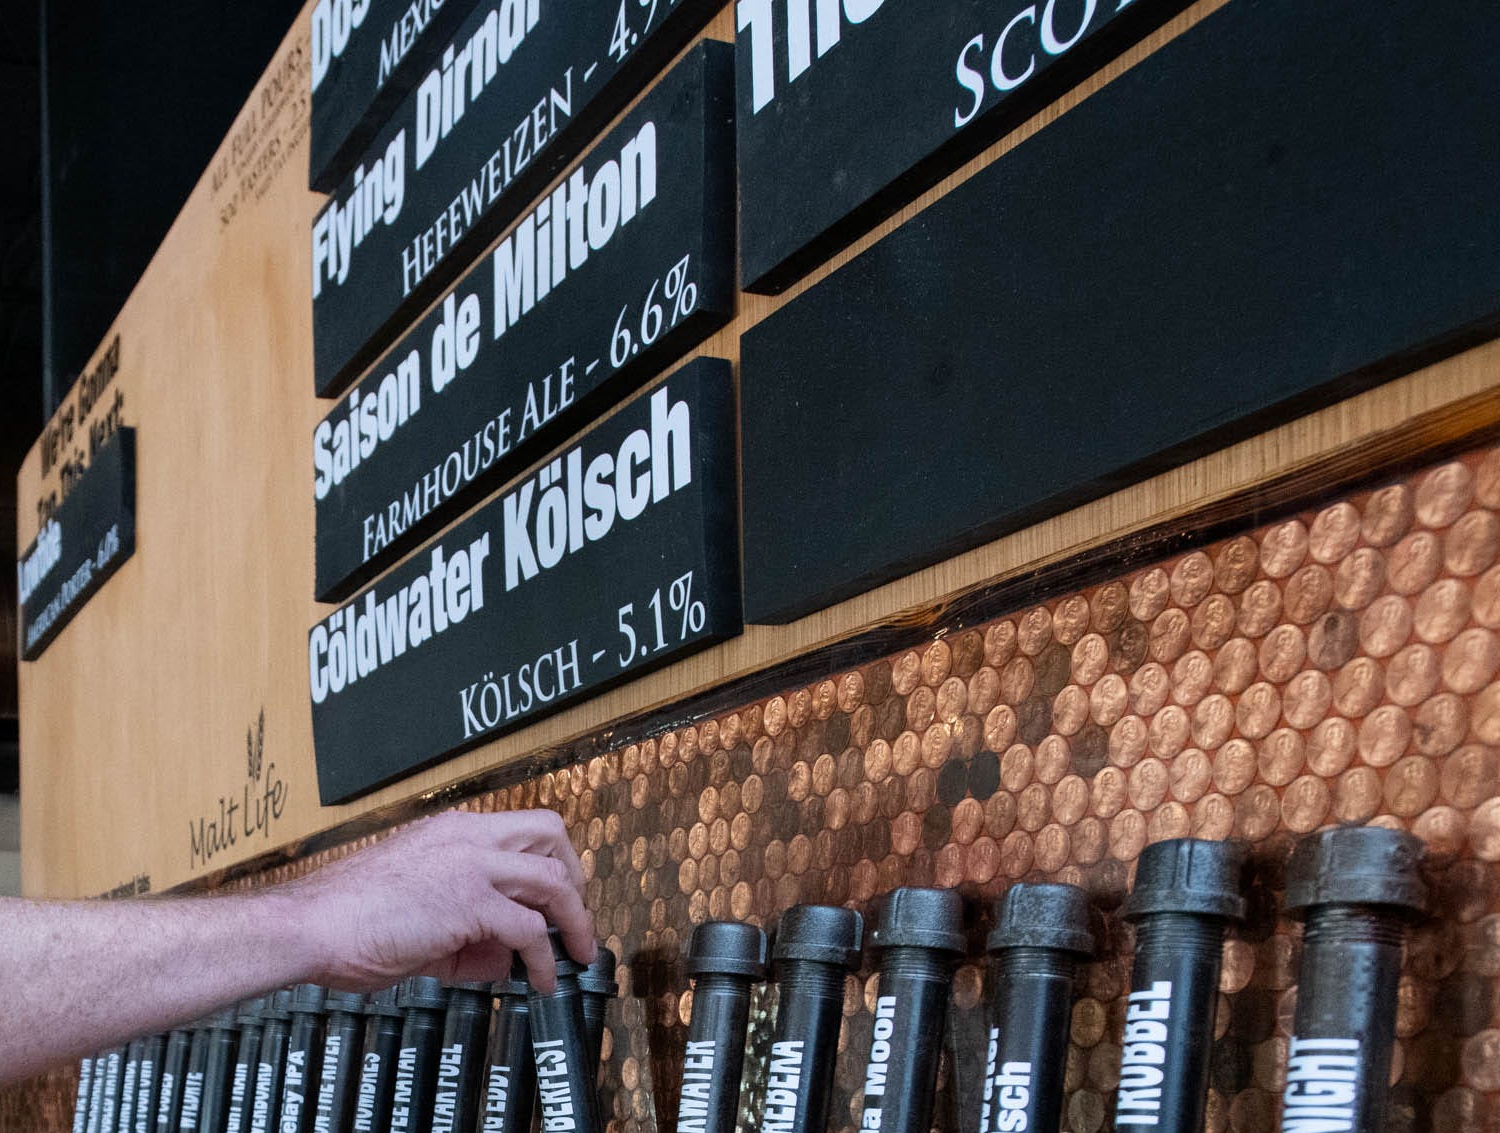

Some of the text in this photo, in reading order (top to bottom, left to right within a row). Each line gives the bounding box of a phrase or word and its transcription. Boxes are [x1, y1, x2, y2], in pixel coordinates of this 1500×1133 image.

[377, 0, 445, 90] MEXI
[737, 0, 886, 117] Th
[954, 0, 1136, 128] SCO
[312, 128, 405, 299] Flying
[402, 66, 573, 298] HEFEWEIZEN
[312, 121, 657, 501] Saison de Milton
[361, 408, 511, 563] FARMHOUSE
[517, 358, 575, 442] ALE
[610, 254, 698, 369] 6.6%
[503, 386, 692, 593] Kölsch
[460, 639, 583, 740] KÖLSCH
[618, 571, 706, 668] 5.1%
[189, 762, 288, 870] Malt Life
[288, 1051, 305, 1086] IPA
[864, 995, 897, 1097] Moon
[1115, 980, 1173, 1127] TRUBBEL
